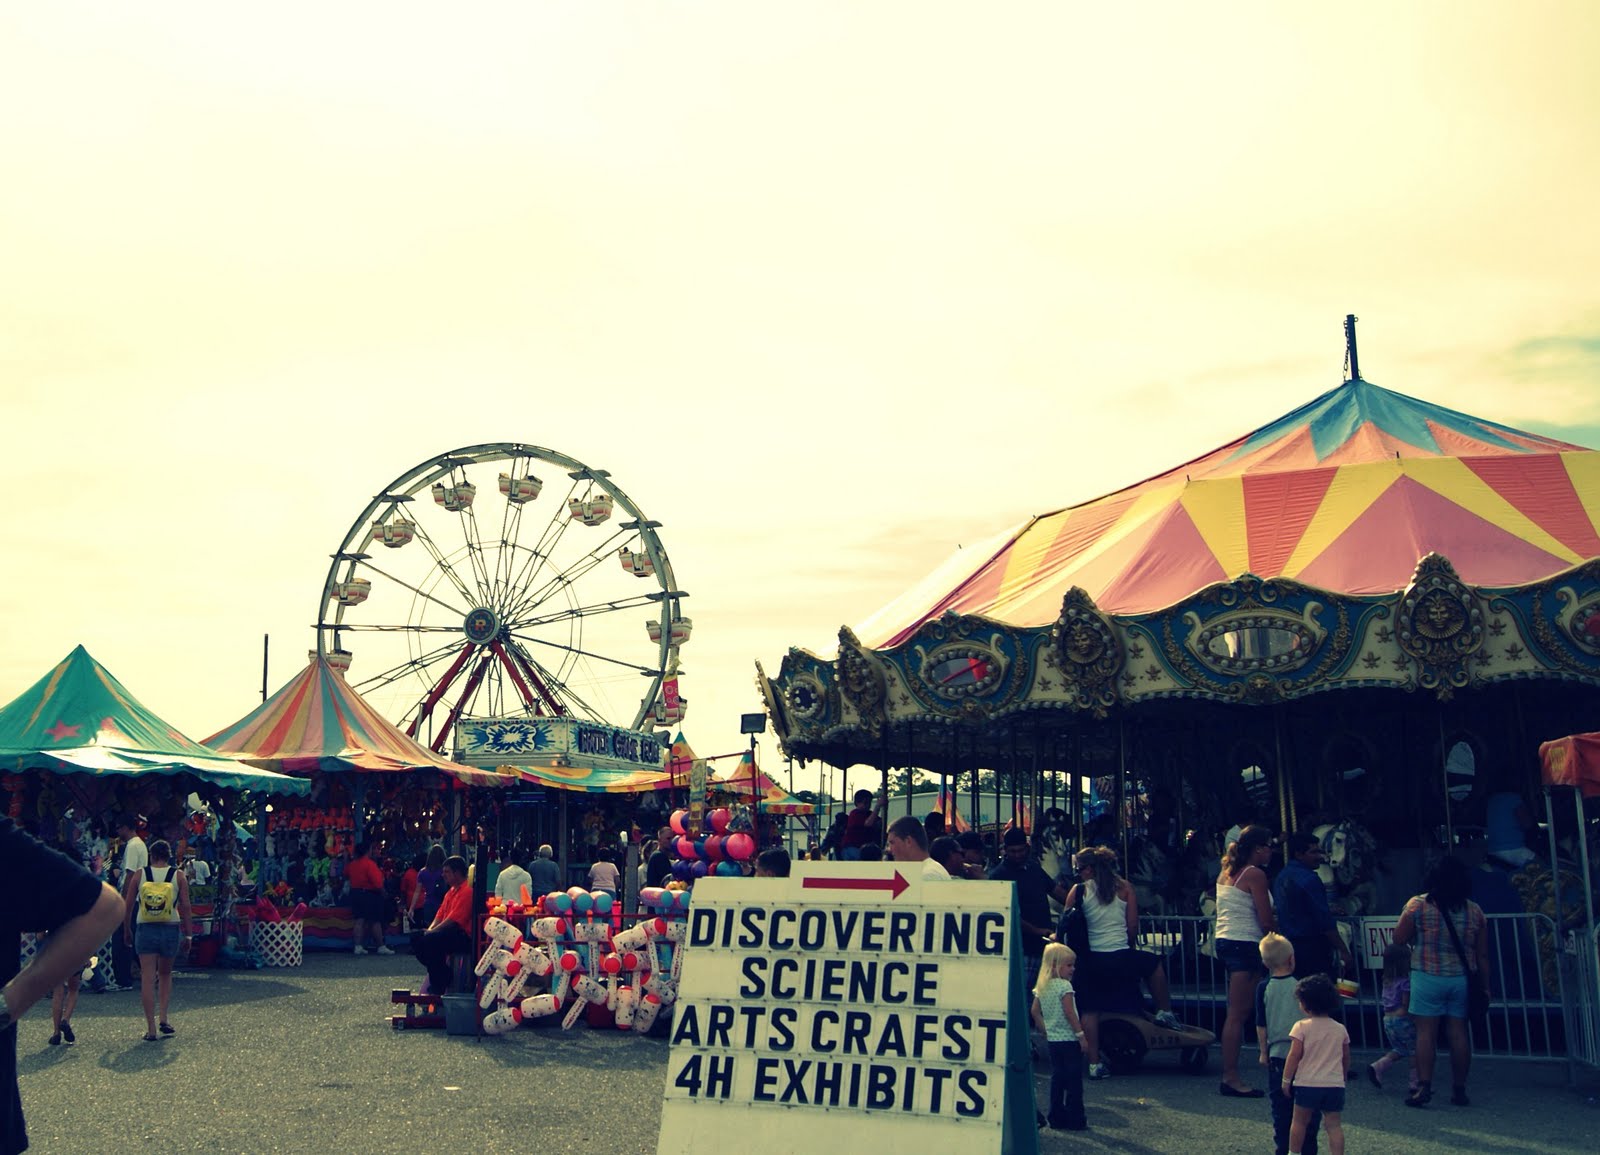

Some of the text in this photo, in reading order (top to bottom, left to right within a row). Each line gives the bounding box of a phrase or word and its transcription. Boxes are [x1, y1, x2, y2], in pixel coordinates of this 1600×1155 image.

[689, 907, 1005, 955] DISCOVERING
[740, 957, 939, 1006] SCIENCE
[672, 1004, 1007, 1064] ARTS CRAFST
[675, 1054, 988, 1118] 4H EXHIBITS
